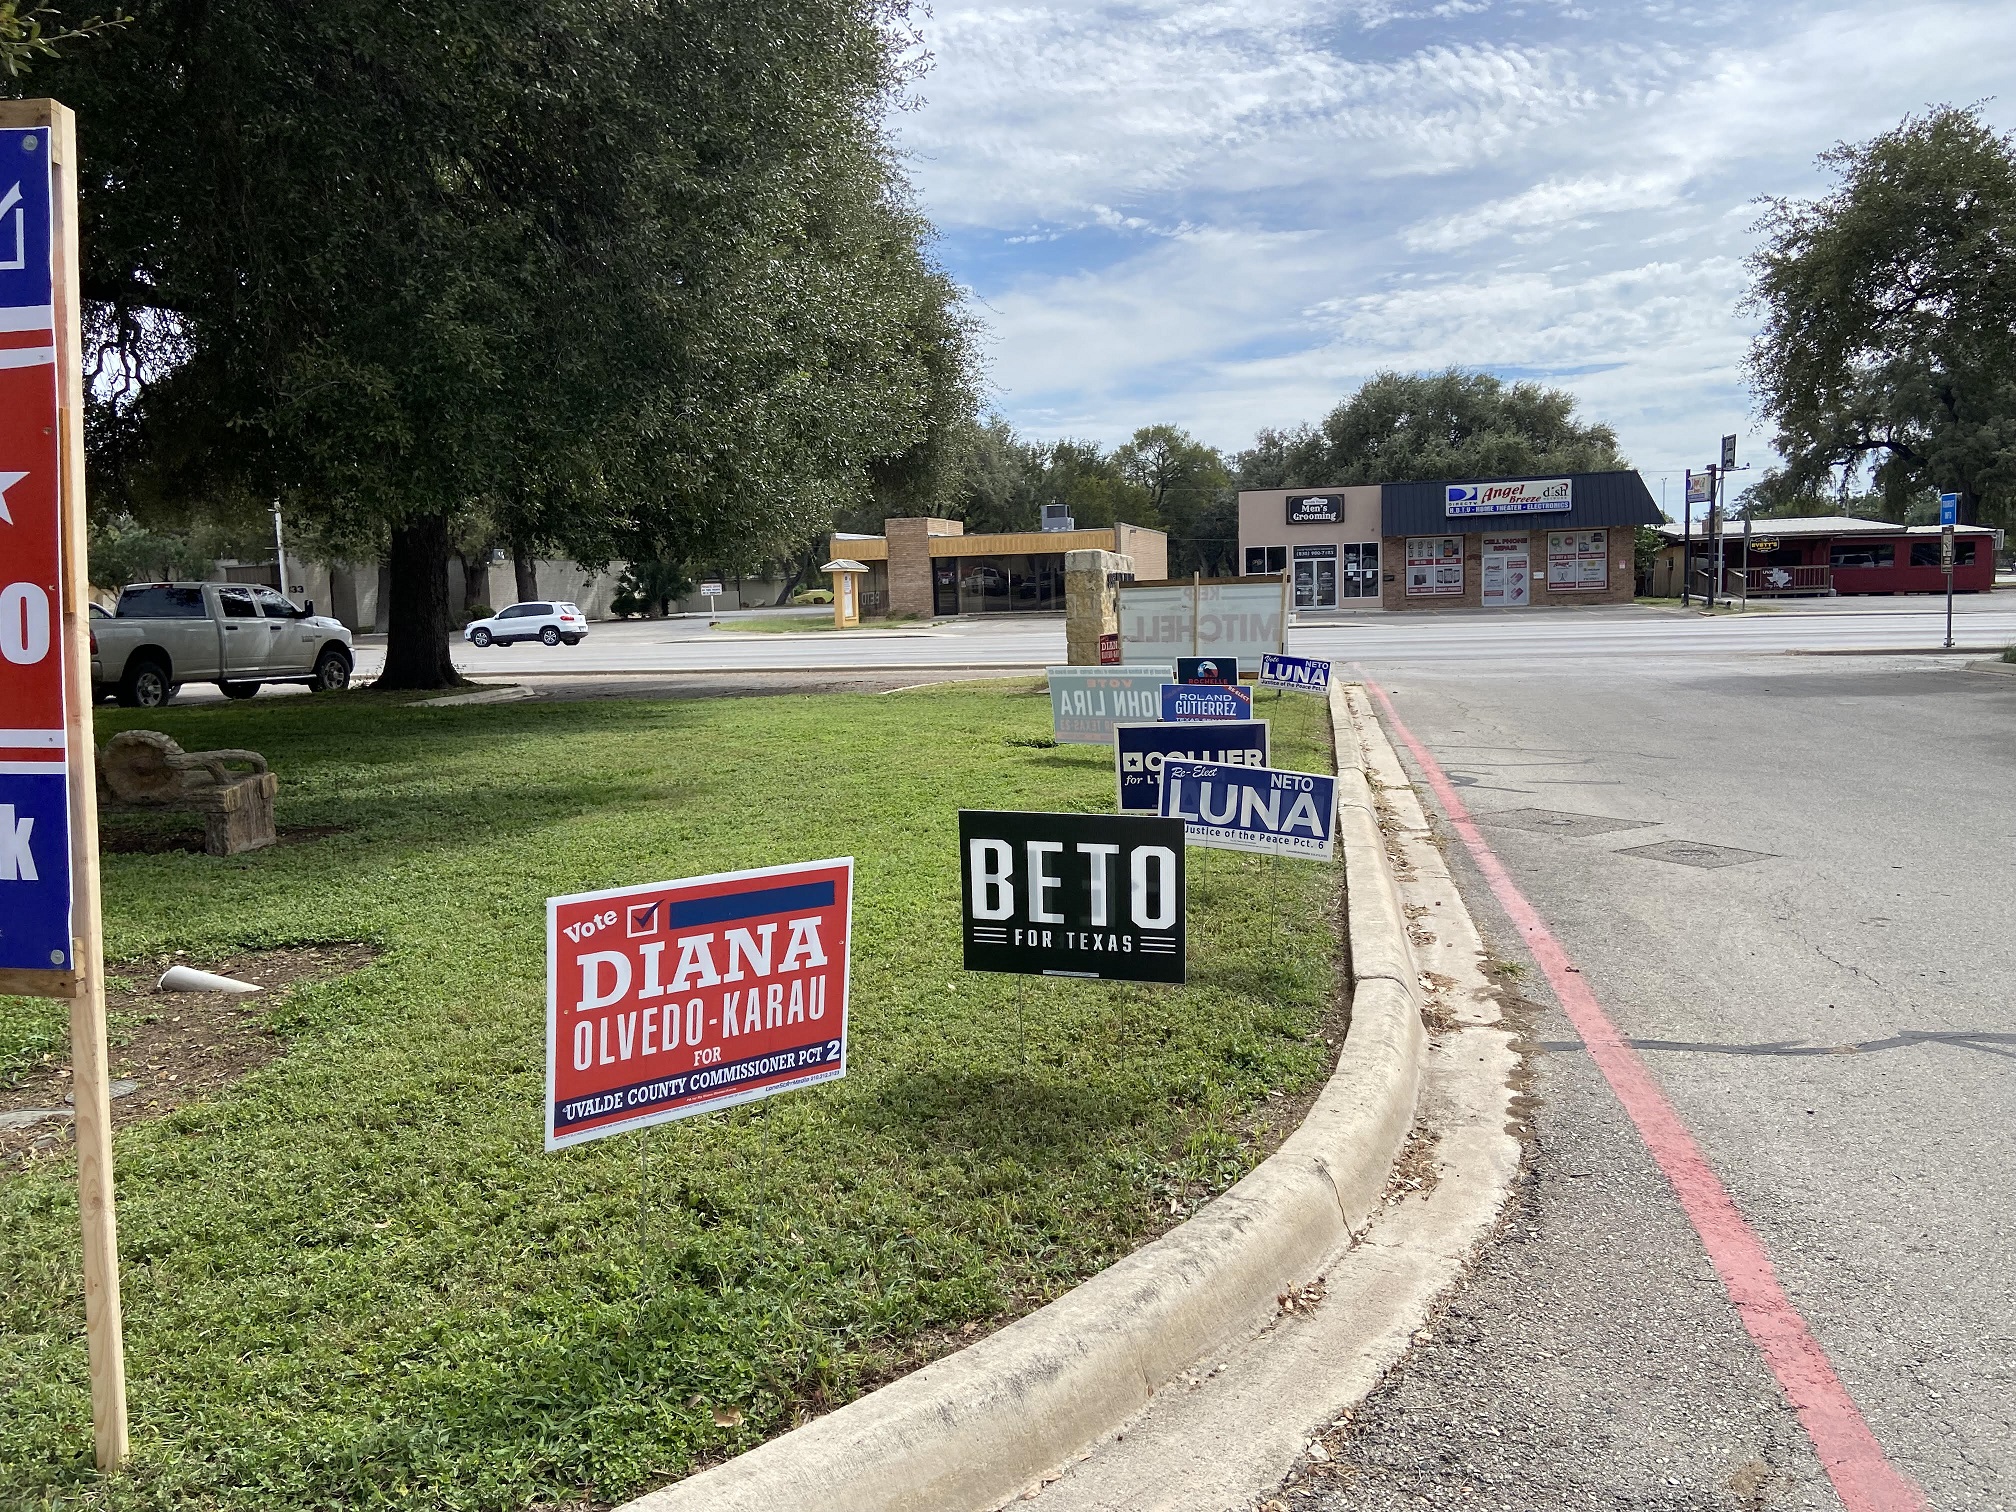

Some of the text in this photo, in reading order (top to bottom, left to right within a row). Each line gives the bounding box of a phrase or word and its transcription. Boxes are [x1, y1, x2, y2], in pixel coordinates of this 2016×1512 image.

[1481, 485, 1525, 504] Angel
[1543, 484, 1568, 497] dish
[1509, 496, 1541, 504] Breeze
[1527, 501, 1569, 509] ELECTRONICS
[1293, 512, 1337, 521] Grooming
[1101, 641, 1118, 651] DIAN
[1261, 662, 1326, 685] LUNA
[1305, 661, 1329, 670] NETO
[1227, 686, 1250, 702] RE-ELECT
[1175, 701, 1237, 716] GUTIERREZ
[1125, 775, 1143, 786] for
[1171, 766, 1218, 778] Re-Elect
[1270, 773, 1314, 791] NETO
[1168, 779, 1325, 838] LUNA
[1185, 825, 1220, 837] Justice
[1224, 830, 1235, 838] of
[1239, 831, 1255, 840] the
[1259, 833, 1290, 845] Peace
[1293, 838, 1314, 848] Pct.
[1318, 841, 1324, 849] 6
[970, 838, 1176, 930] BETO
[563, 909, 618, 944] Vote
[1014, 929, 1132, 953] FOR TEXAS
[576, 915, 828, 1013] DIANA
[573, 974, 826, 1072] OLVEDO-KARAU
[693, 1047, 721, 1067] FOR
[566, 1092, 623, 1121] UVALDE
[628, 1077, 687, 1105] COUNTY
[690, 1052, 796, 1090] COMMISSIONER
[799, 1047, 823, 1066] PCT
[826, 1040, 841, 1062] 2
